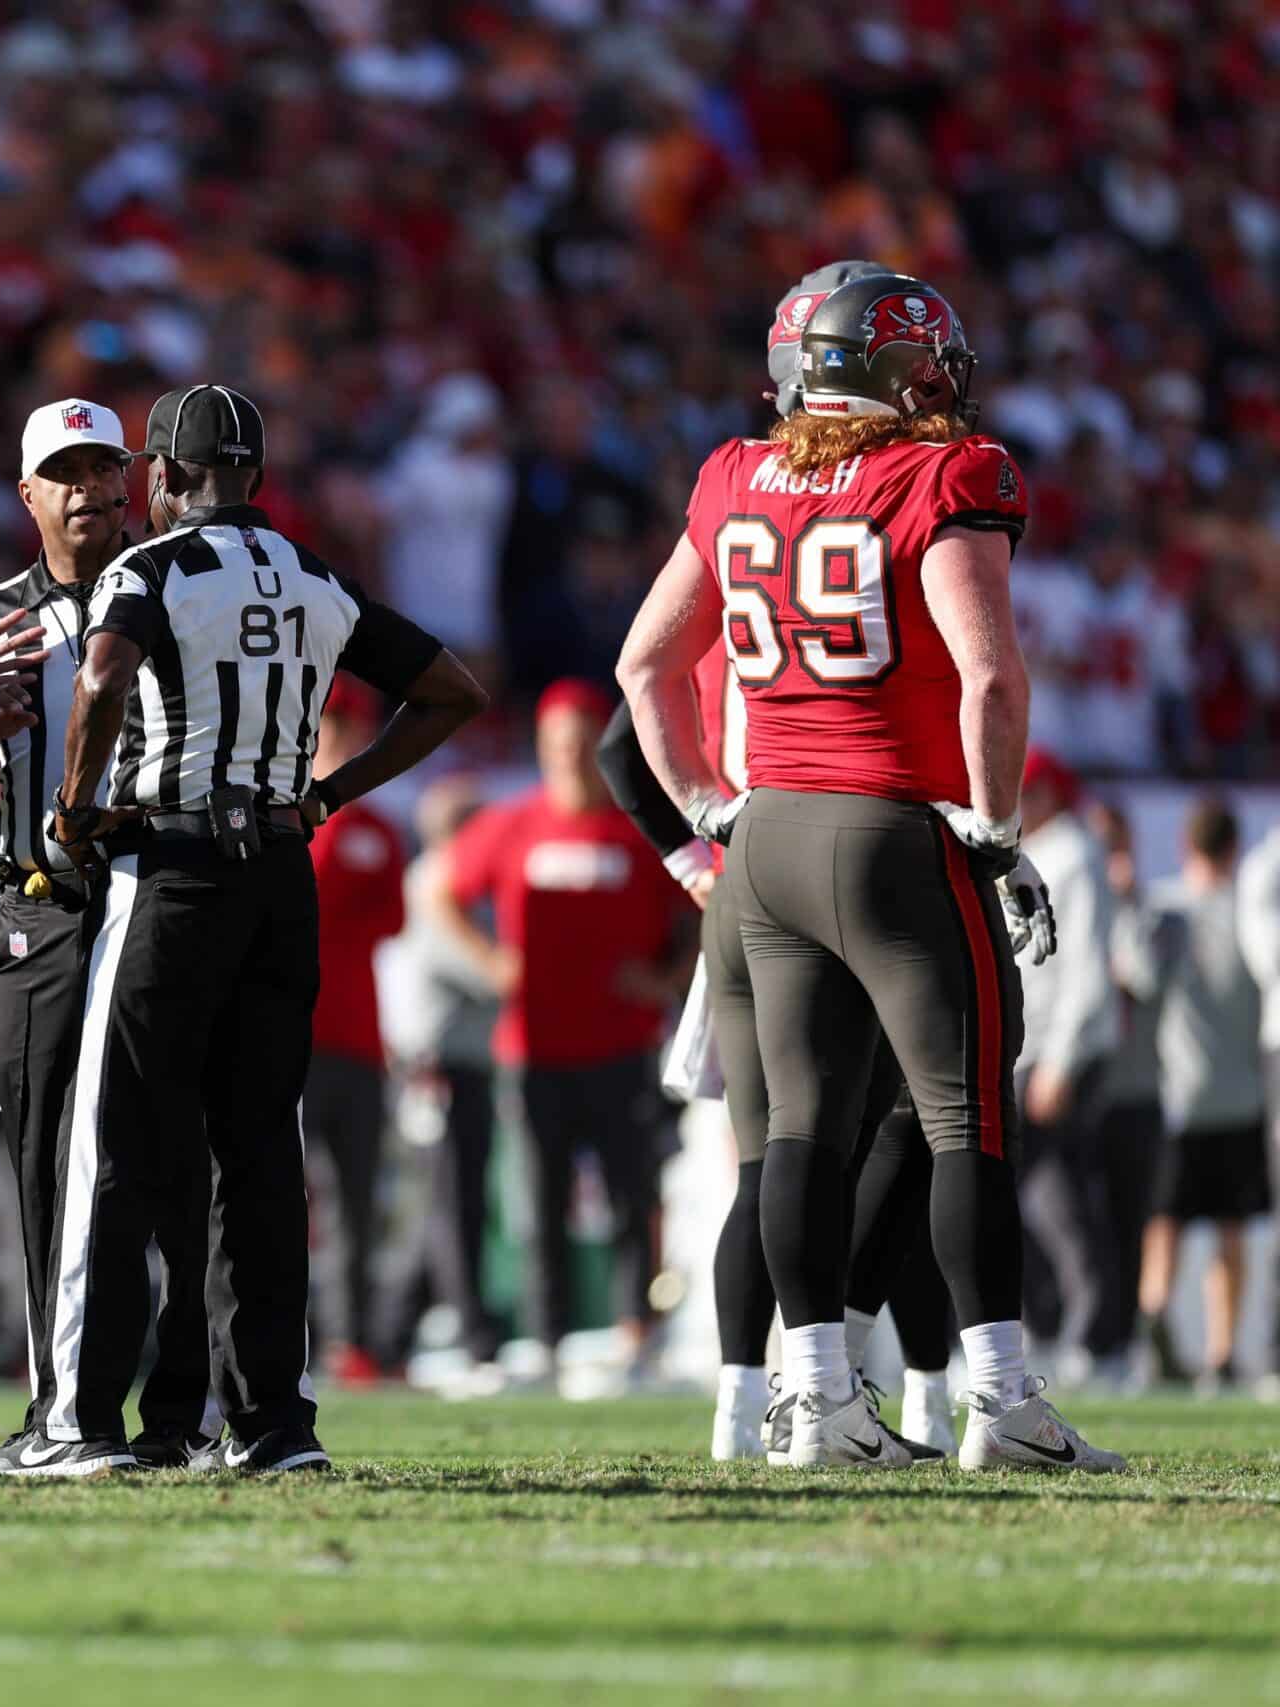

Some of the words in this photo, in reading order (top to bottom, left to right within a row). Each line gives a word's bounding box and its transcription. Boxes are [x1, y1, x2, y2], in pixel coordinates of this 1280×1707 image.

[65, 415, 93, 429] NFL
[254, 571, 282, 598] U
[716, 514, 902, 688] 69
[239, 604, 305, 658] 81
